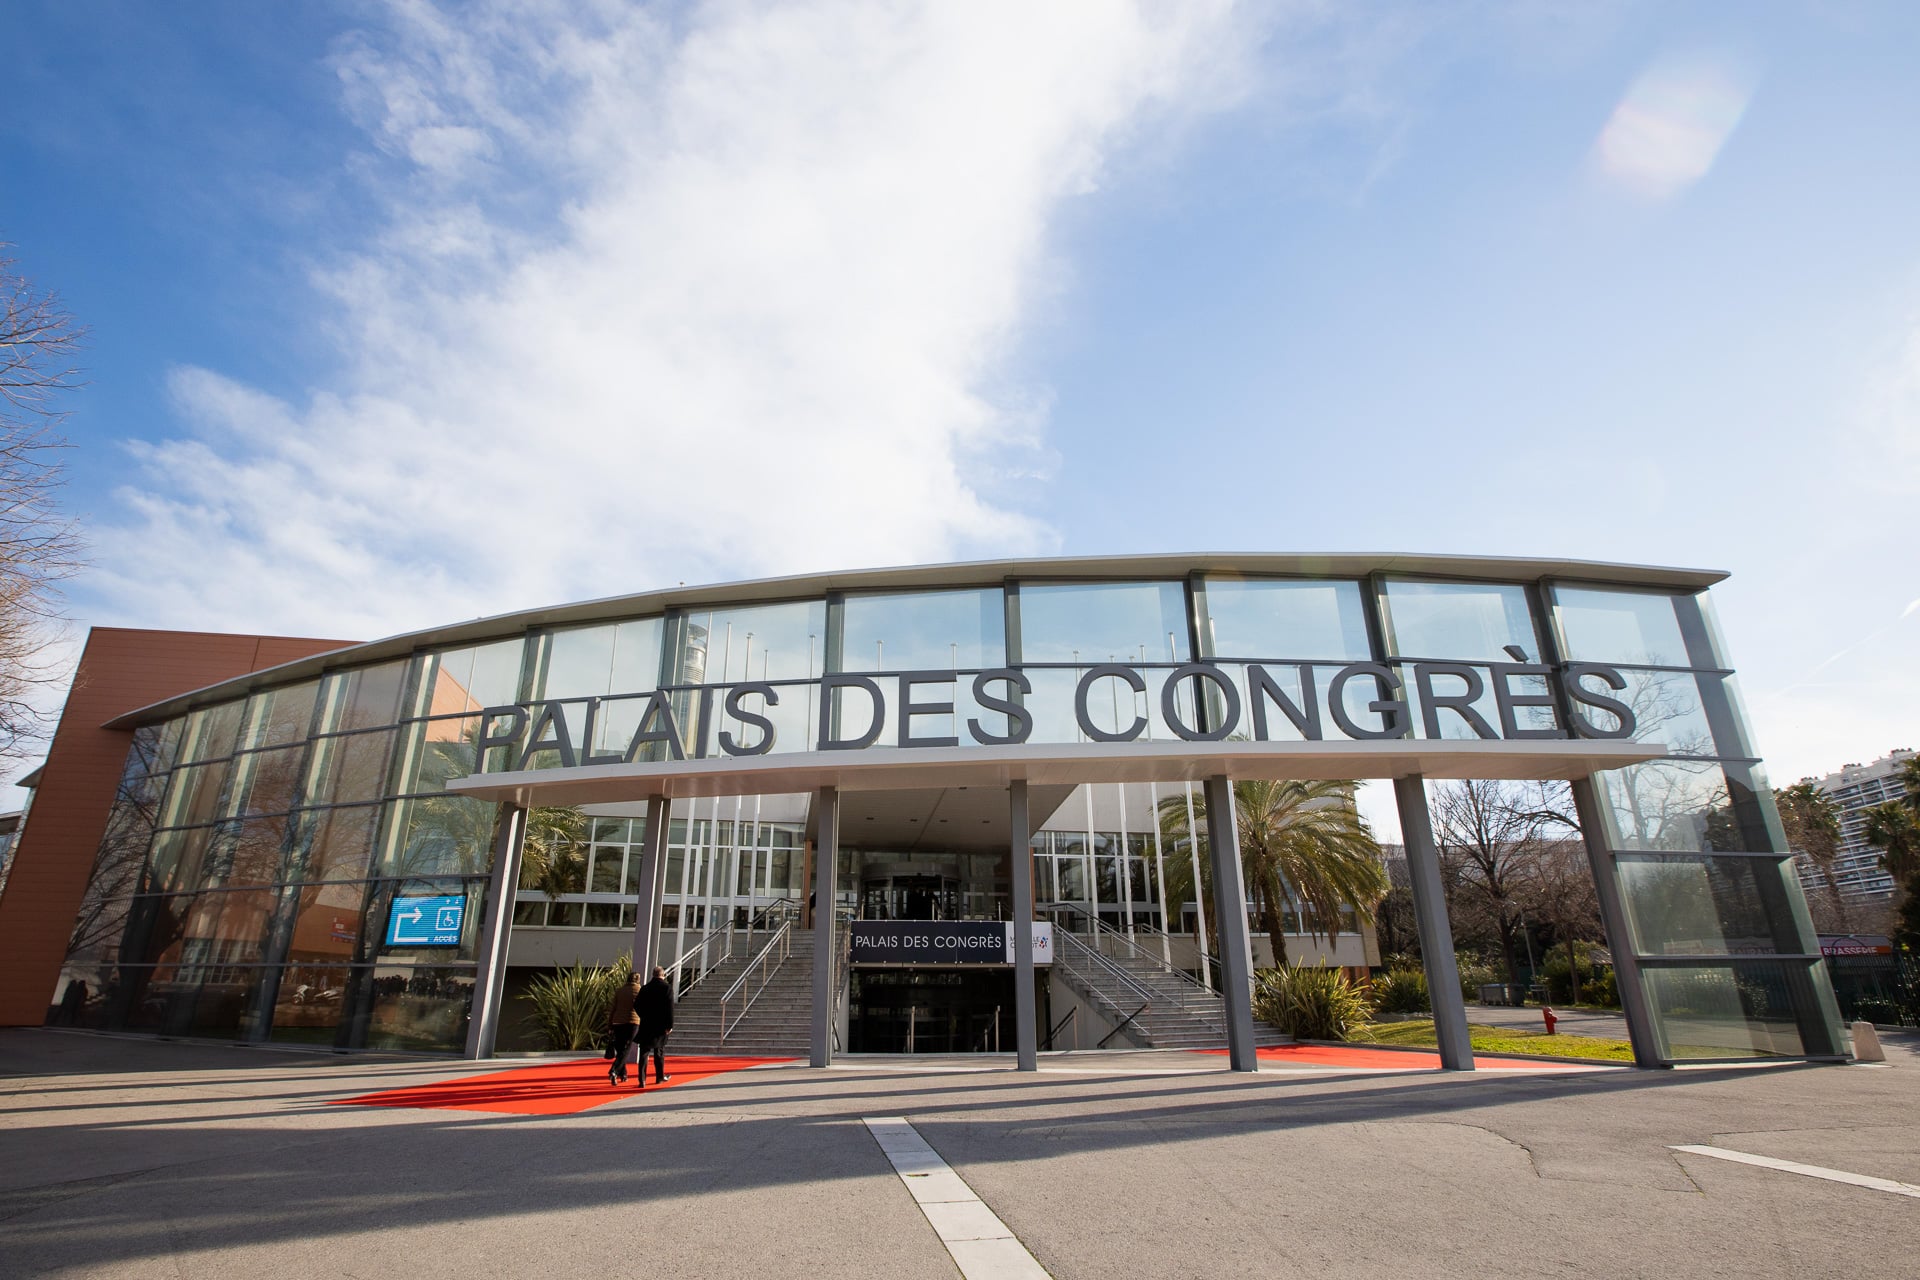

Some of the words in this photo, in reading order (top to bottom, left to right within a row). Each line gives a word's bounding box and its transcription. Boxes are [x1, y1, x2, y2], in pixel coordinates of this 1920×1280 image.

[475, 682, 779, 775] PALAIS
[817, 668, 1033, 752] DES
[1074, 645, 1637, 742] CONGRÈS
[855, 935, 898, 948] PALAIS
[903, 935, 929, 948] DES
[934, 933, 1002, 948] CONGRÈS
